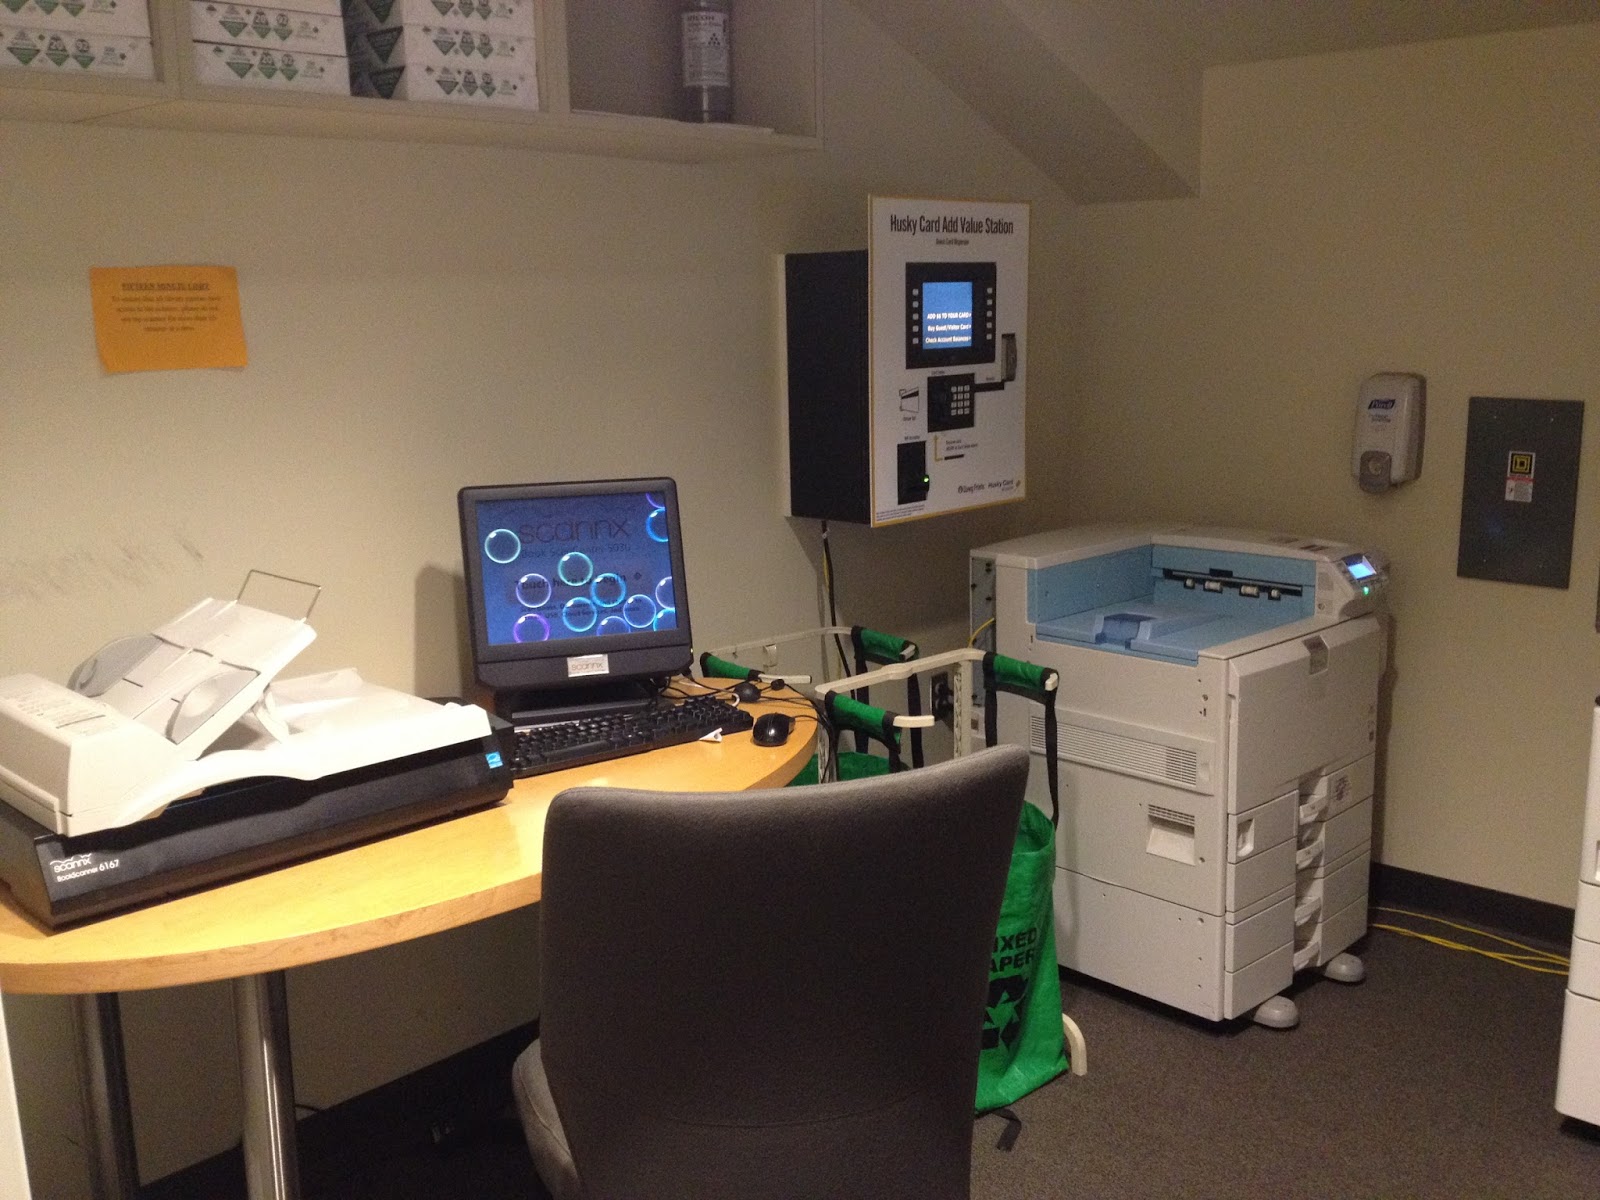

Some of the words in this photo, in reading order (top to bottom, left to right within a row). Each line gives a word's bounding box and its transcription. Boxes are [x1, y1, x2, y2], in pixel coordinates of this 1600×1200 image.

[890, 214, 918, 235] Husky
[920, 215, 940, 232] Card
[942, 215, 958, 233] Add
[960, 216, 983, 233] Value
[985, 217, 1014, 234] Station
[518, 518, 630, 544] scannx
[571, 662, 604, 671] scannx
[53, 856, 92, 873] scannx
[99, 859, 119, 872] 6167
[993, 927, 1037, 953] IXED
[990, 949, 1035, 973] APER
